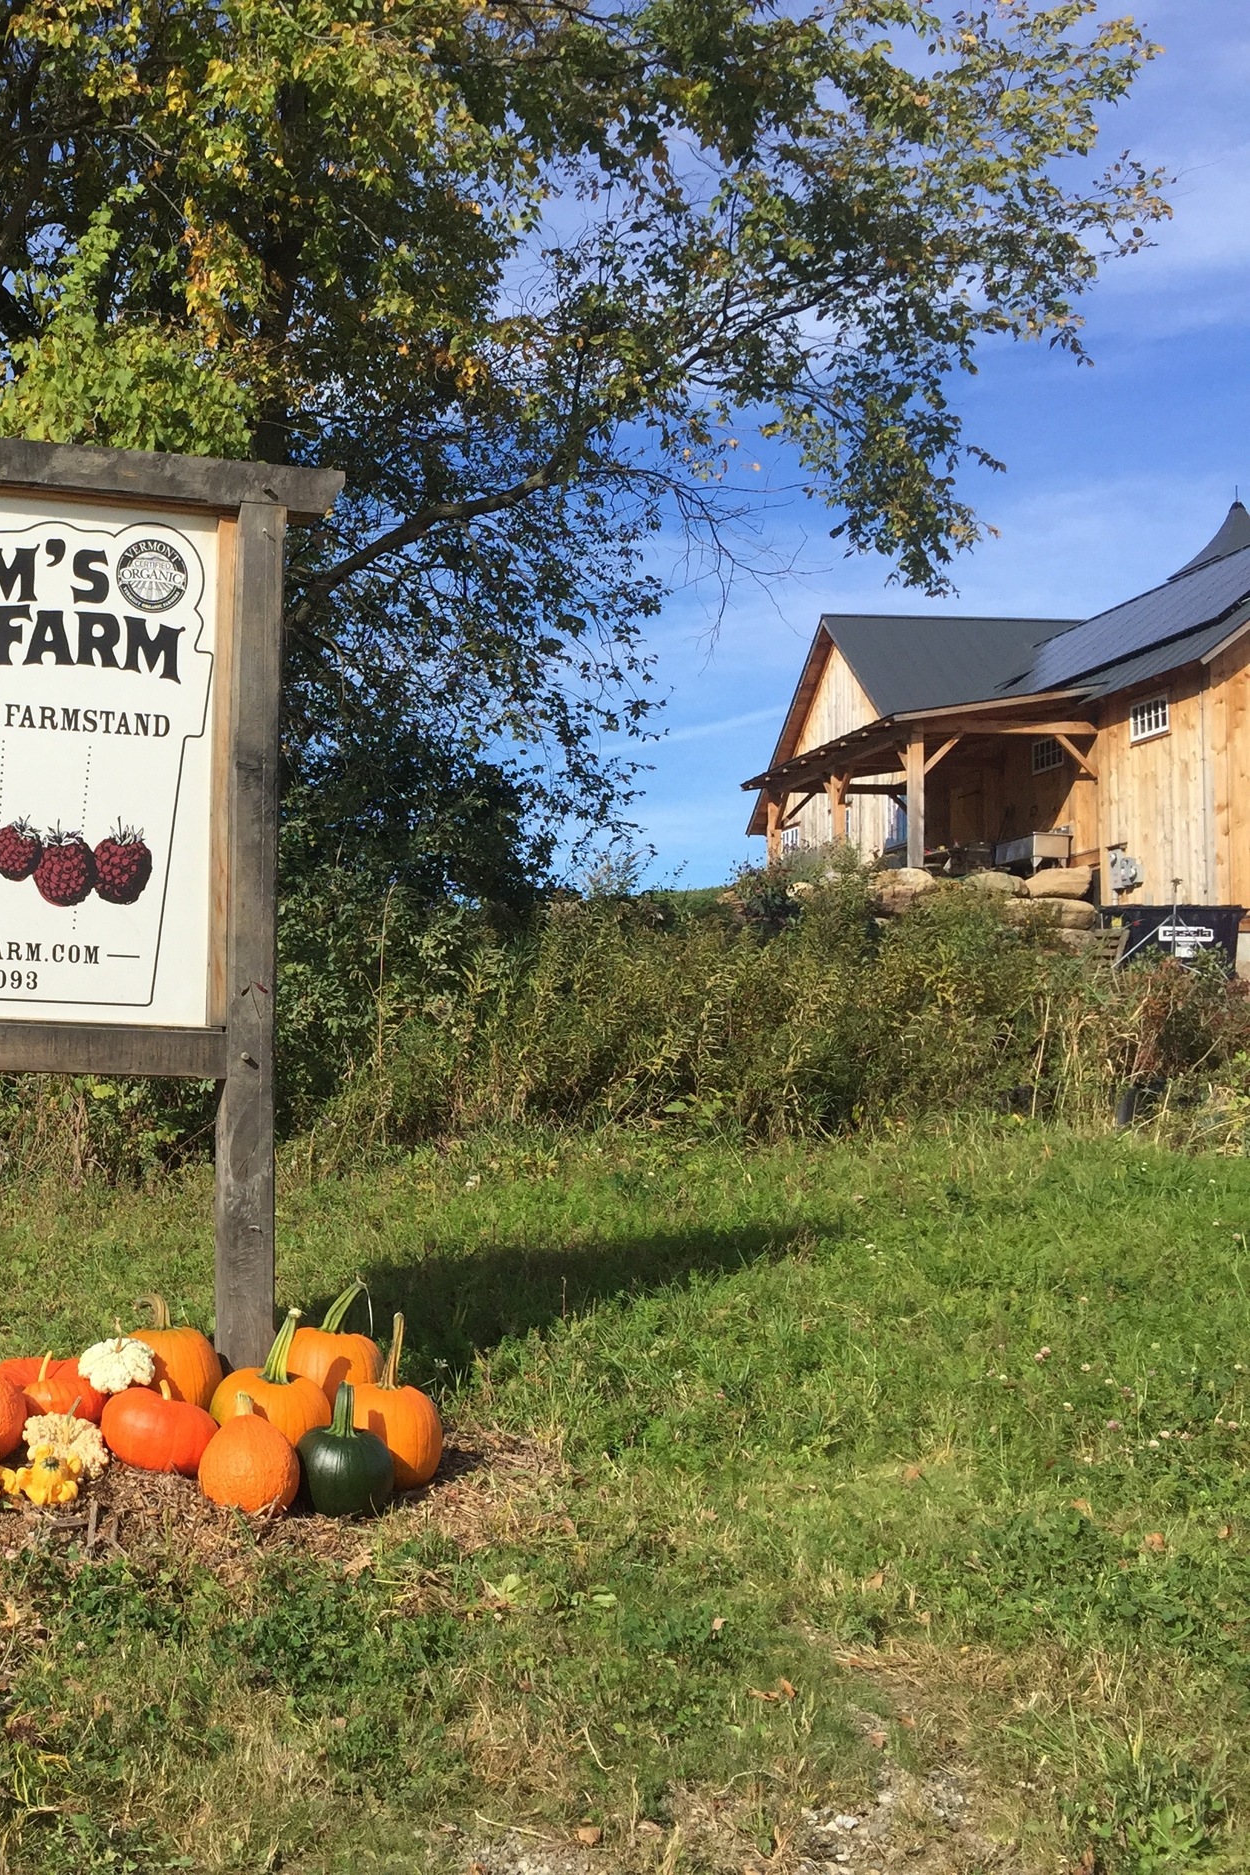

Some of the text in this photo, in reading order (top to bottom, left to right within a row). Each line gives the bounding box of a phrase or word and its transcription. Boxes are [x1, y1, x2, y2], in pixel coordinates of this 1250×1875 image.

[124, 541, 181, 563] VERMONT
[134, 560, 172, 570] CERTIFIED
[121, 568, 182, 585] ORGANIC
[4, 703, 171, 738] FARMSTAND
